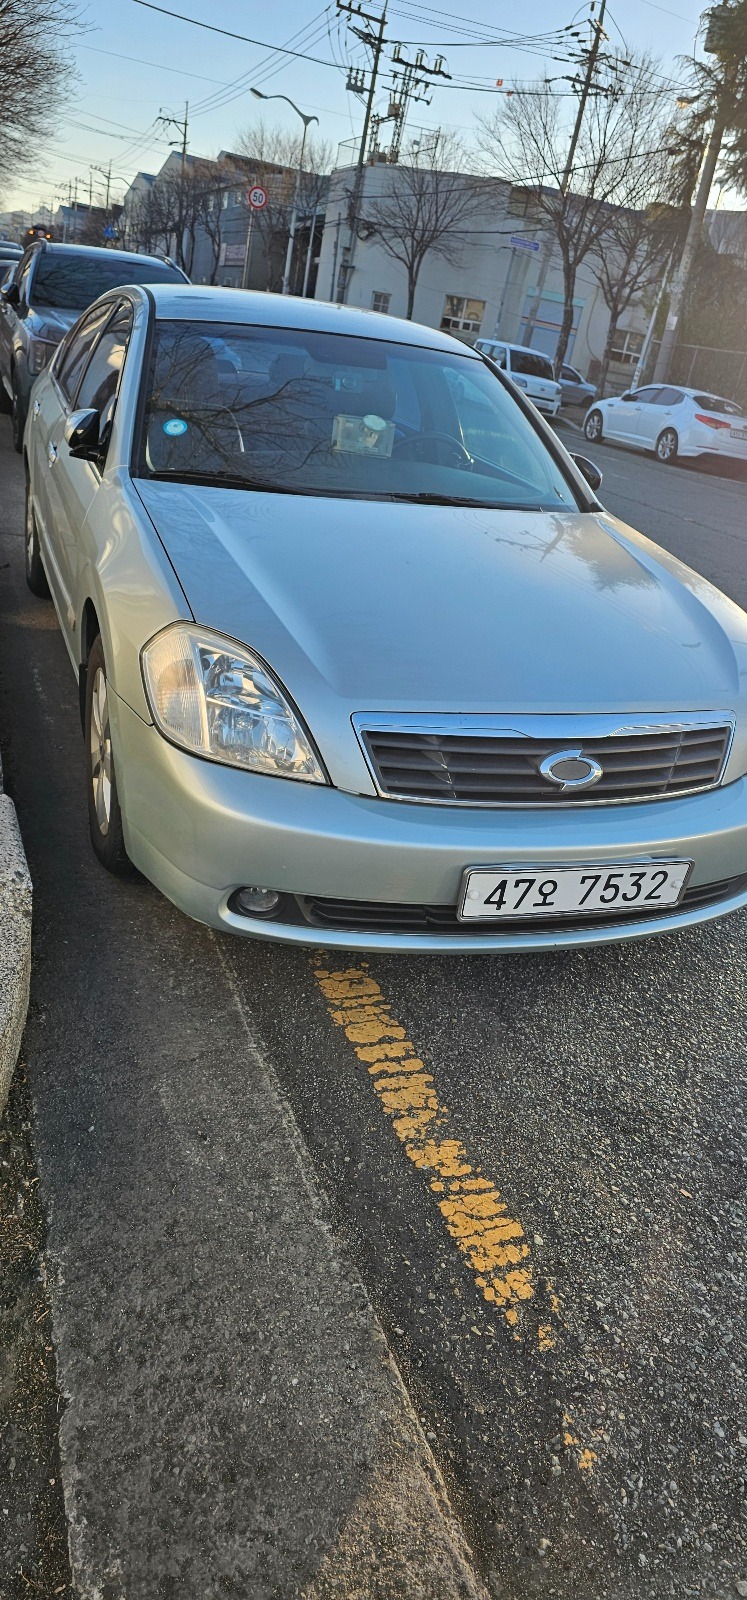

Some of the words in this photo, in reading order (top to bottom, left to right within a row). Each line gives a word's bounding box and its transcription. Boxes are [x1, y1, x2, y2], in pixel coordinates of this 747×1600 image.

[252, 191, 264, 204] 50
[483, 878, 558, 911] 47오
[578, 870, 669, 906] 7532
